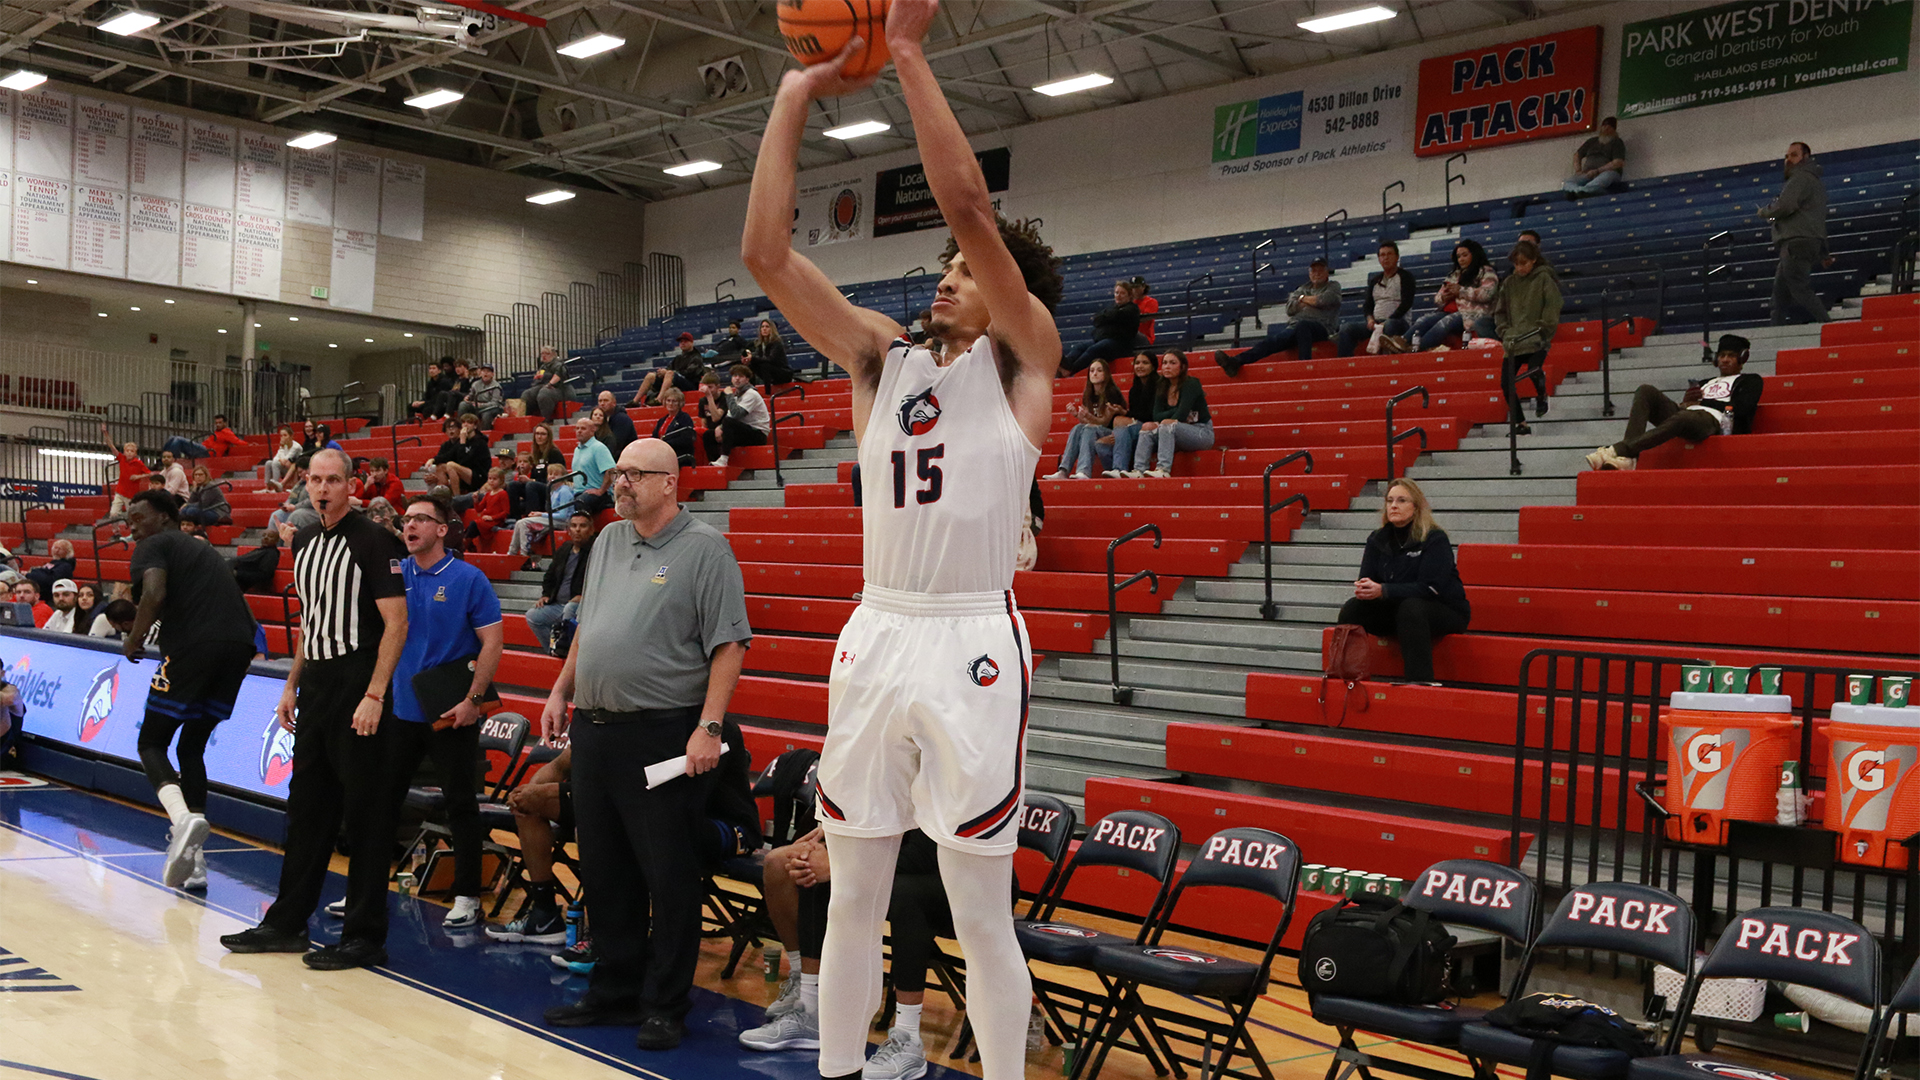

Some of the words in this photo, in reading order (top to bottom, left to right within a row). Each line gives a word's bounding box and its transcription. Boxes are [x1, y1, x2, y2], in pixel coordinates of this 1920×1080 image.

[1626, 20, 1694, 57] PARK
[1703, 3, 1780, 41] WEST
[1788, 0, 1906, 26] DEN
[1664, 46, 1717, 68] General
[1722, 33, 1786, 58] Dentistry
[1790, 28, 1812, 45] for
[1816, 18, 1860, 39] Youth
[1451, 40, 1557, 94] PACK
[1760, 51, 1818, 70] ESPAÑOL!
[1623, 92, 1697, 114] Appointments
[1700, 77, 1777, 100] 719-545-0914
[1794, 55, 1899, 84] YouthDental.com
[22, 92, 68, 108] VOLLEYBALL
[1307, 94, 1334, 114] 4530
[1338, 90, 1368, 109] Dillon
[1373, 85, 1401, 103] Drive
[22, 106, 67, 119] TOURNAMENT
[28, 102, 60, 112] NATIONAL
[80, 105, 126, 120] WRESTLING
[1260, 106, 1288, 118] Holiday
[1288, 104, 1301, 113] Inn
[22, 112, 66, 125] APPEARANCES
[86, 113, 118, 124] NATIONAL
[136, 116, 180, 130] FOOTBALL
[1325, 110, 1379, 134] 542-8888
[1419, 87, 1585, 149] ATTACK!
[1259, 117, 1299, 135] Express
[193, 127, 230, 141] SOFTBALL
[244, 138, 282, 152] BASEBALL
[316, 152, 332, 160] GOLF
[1252, 156, 1295, 171] Sponsor
[1298, 152, 1309, 164] of
[1312, 150, 1335, 162] Pack
[26, 178, 60, 189] WOMEN'S
[900, 172, 925, 187] Local
[26, 192, 58, 202] NATIONAL
[28, 185, 58, 196] TENNIS
[88, 188, 112, 198] MEN'S
[896, 188, 934, 205] Nationw
[20, 196, 65, 208] TOURNAMENT
[20, 202, 64, 214] APPEARANCES
[84, 202, 115, 212] NATIONAL
[88, 196, 114, 206] TENNIS
[140, 196, 171, 208] WOMEN'S
[78, 206, 122, 218] TOURNAMENT
[138, 210, 172, 220] NATIONAL
[143, 204, 168, 214] SOCCER
[193, 206, 224, 217] WOMEN'S
[78, 212, 121, 223] APPEARANCES
[132, 214, 177, 226] TOURNAMENT
[185, 211, 203, 220] CROSS
[204, 214, 232, 225] COUNTRY
[193, 219, 224, 229] NATIONAL
[132, 220, 177, 232] APPEARANCES
[186, 224, 230, 235] TOURNAMENT
[237, 220, 254, 228] CROSS
[256, 223, 281, 233] COUNTRY
[244, 228, 274, 237] NATIONAL
[186, 230, 229, 241] APPEARANCES
[238, 232, 280, 244] TOURNAMENT
[238, 238, 279, 249] APPEARANCES
[314, 288, 325, 296] EXIT
[891, 443, 944, 509] 15
[1688, 670, 1701, 685] G
[481, 718, 518, 740] PACK
[1688, 734, 1722, 773] G
[1848, 750, 1884, 792] G
[1019, 805, 1060, 833] ACK
[1094, 818, 1164, 852] PACK
[1204, 836, 1287, 870] PACK
[1422, 869, 1520, 908] PACK
[1568, 891, 1677, 934] PACK
[1736, 918, 1860, 966] PACK
